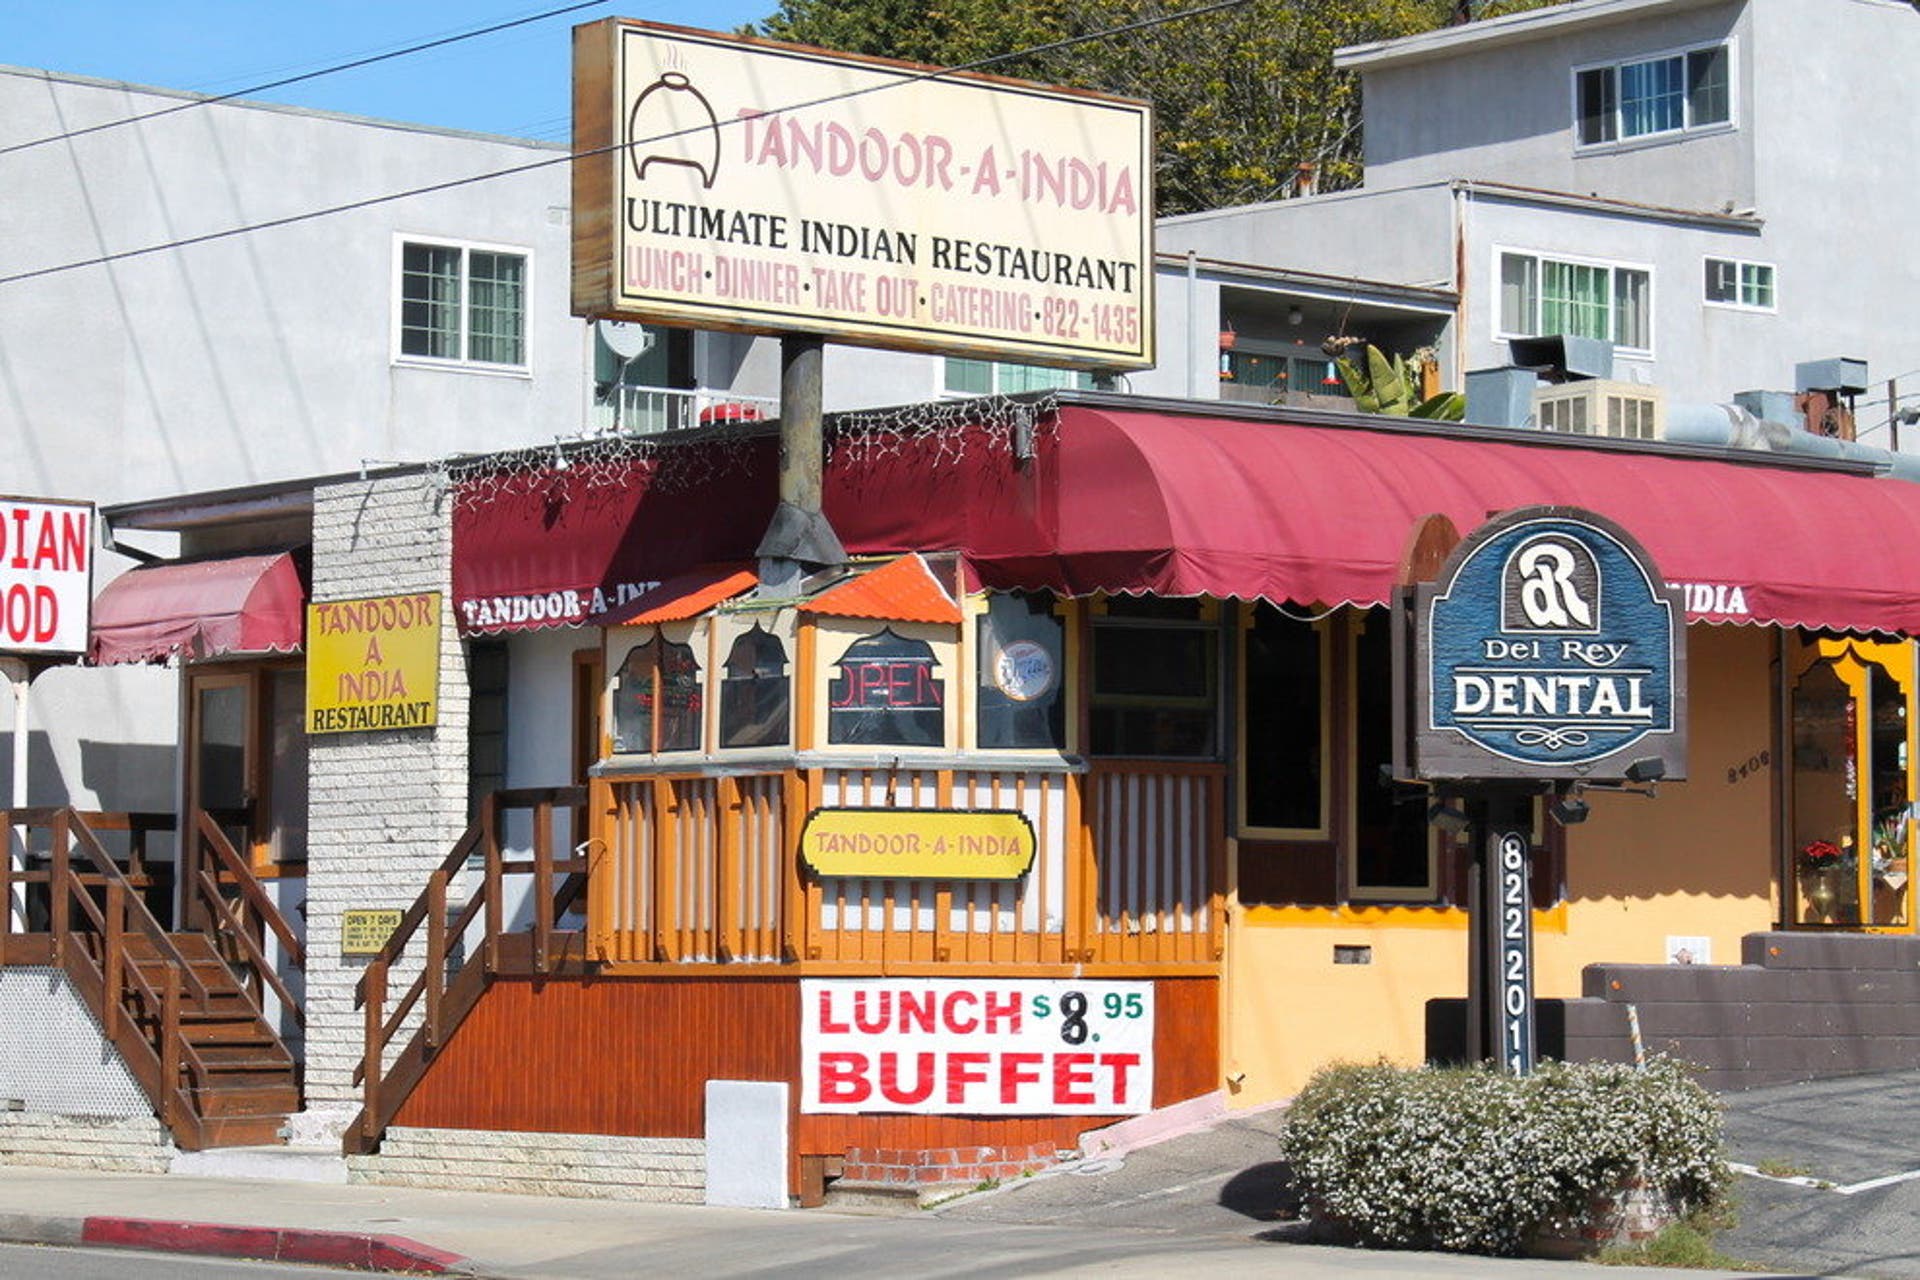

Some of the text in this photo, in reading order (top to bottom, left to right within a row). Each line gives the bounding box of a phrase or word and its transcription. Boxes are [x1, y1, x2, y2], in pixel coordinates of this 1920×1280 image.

[737, 107, 1137, 217] TANDOOR-A-INDIA
[627, 198, 1137, 293] ULTIMATE INDIAN RESTAURANT
[627, 246, 1138, 345] LUNCH DINNER TAKE OUT CATERING 822-1435
[0, 509, 86, 572] IAN
[0, 583, 59, 643] OD
[316, 594, 433, 636] TANDOOR
[364, 636, 382, 666] A
[1484, 639, 1629, 667] Del Rey
[338, 669, 408, 703] INDIA
[1453, 675, 1654, 719] DENTAL
[313, 702, 431, 731] RESTAURANT
[815, 832, 1022, 857] TANDOOR-A-INDIA
[818, 990, 1023, 1035] LUNCH
[818, 1052, 1141, 1106] BUFFET
